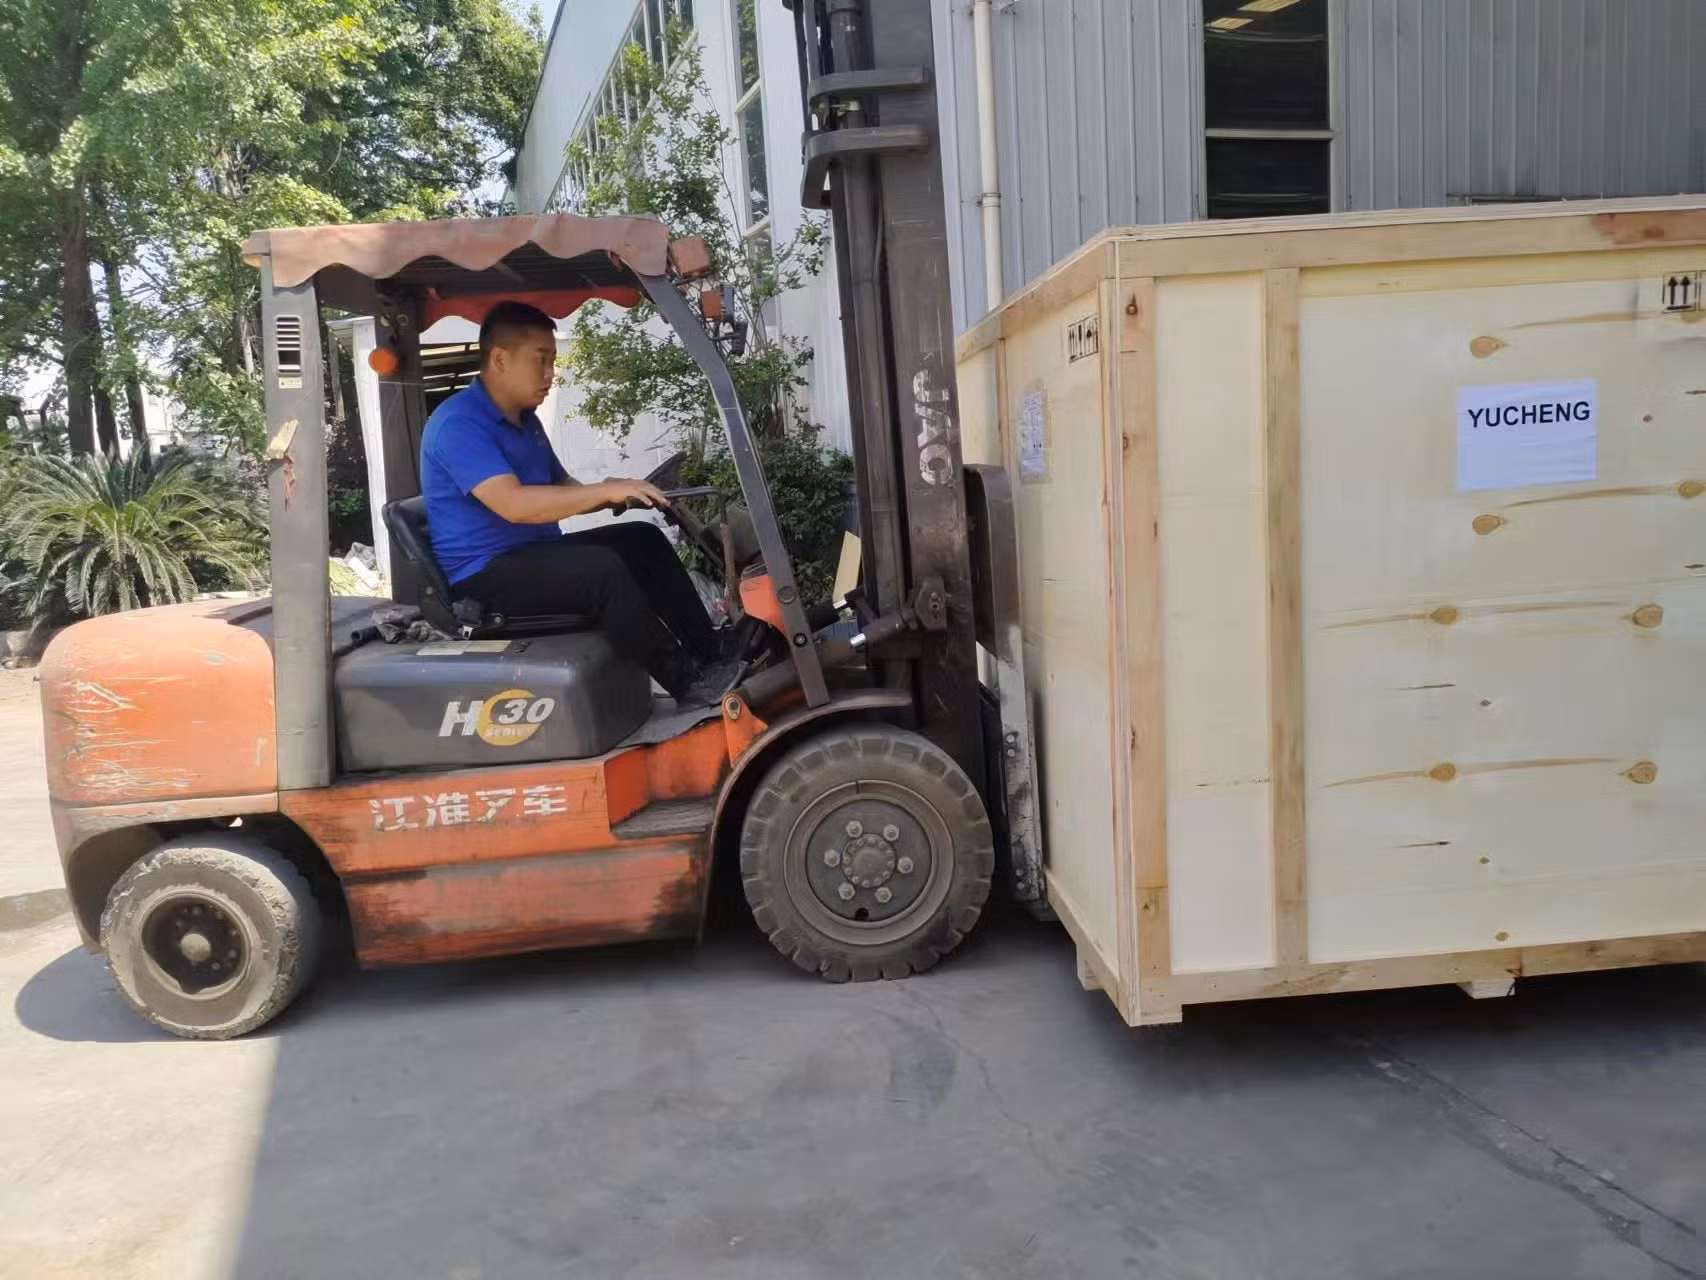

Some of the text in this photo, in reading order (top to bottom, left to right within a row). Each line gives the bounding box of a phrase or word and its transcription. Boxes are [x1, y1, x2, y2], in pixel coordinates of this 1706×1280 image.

[912, 369, 953, 486] JAC
[1467, 401, 1591, 428] YUCHENG
[485, 727, 534, 738] SERI
